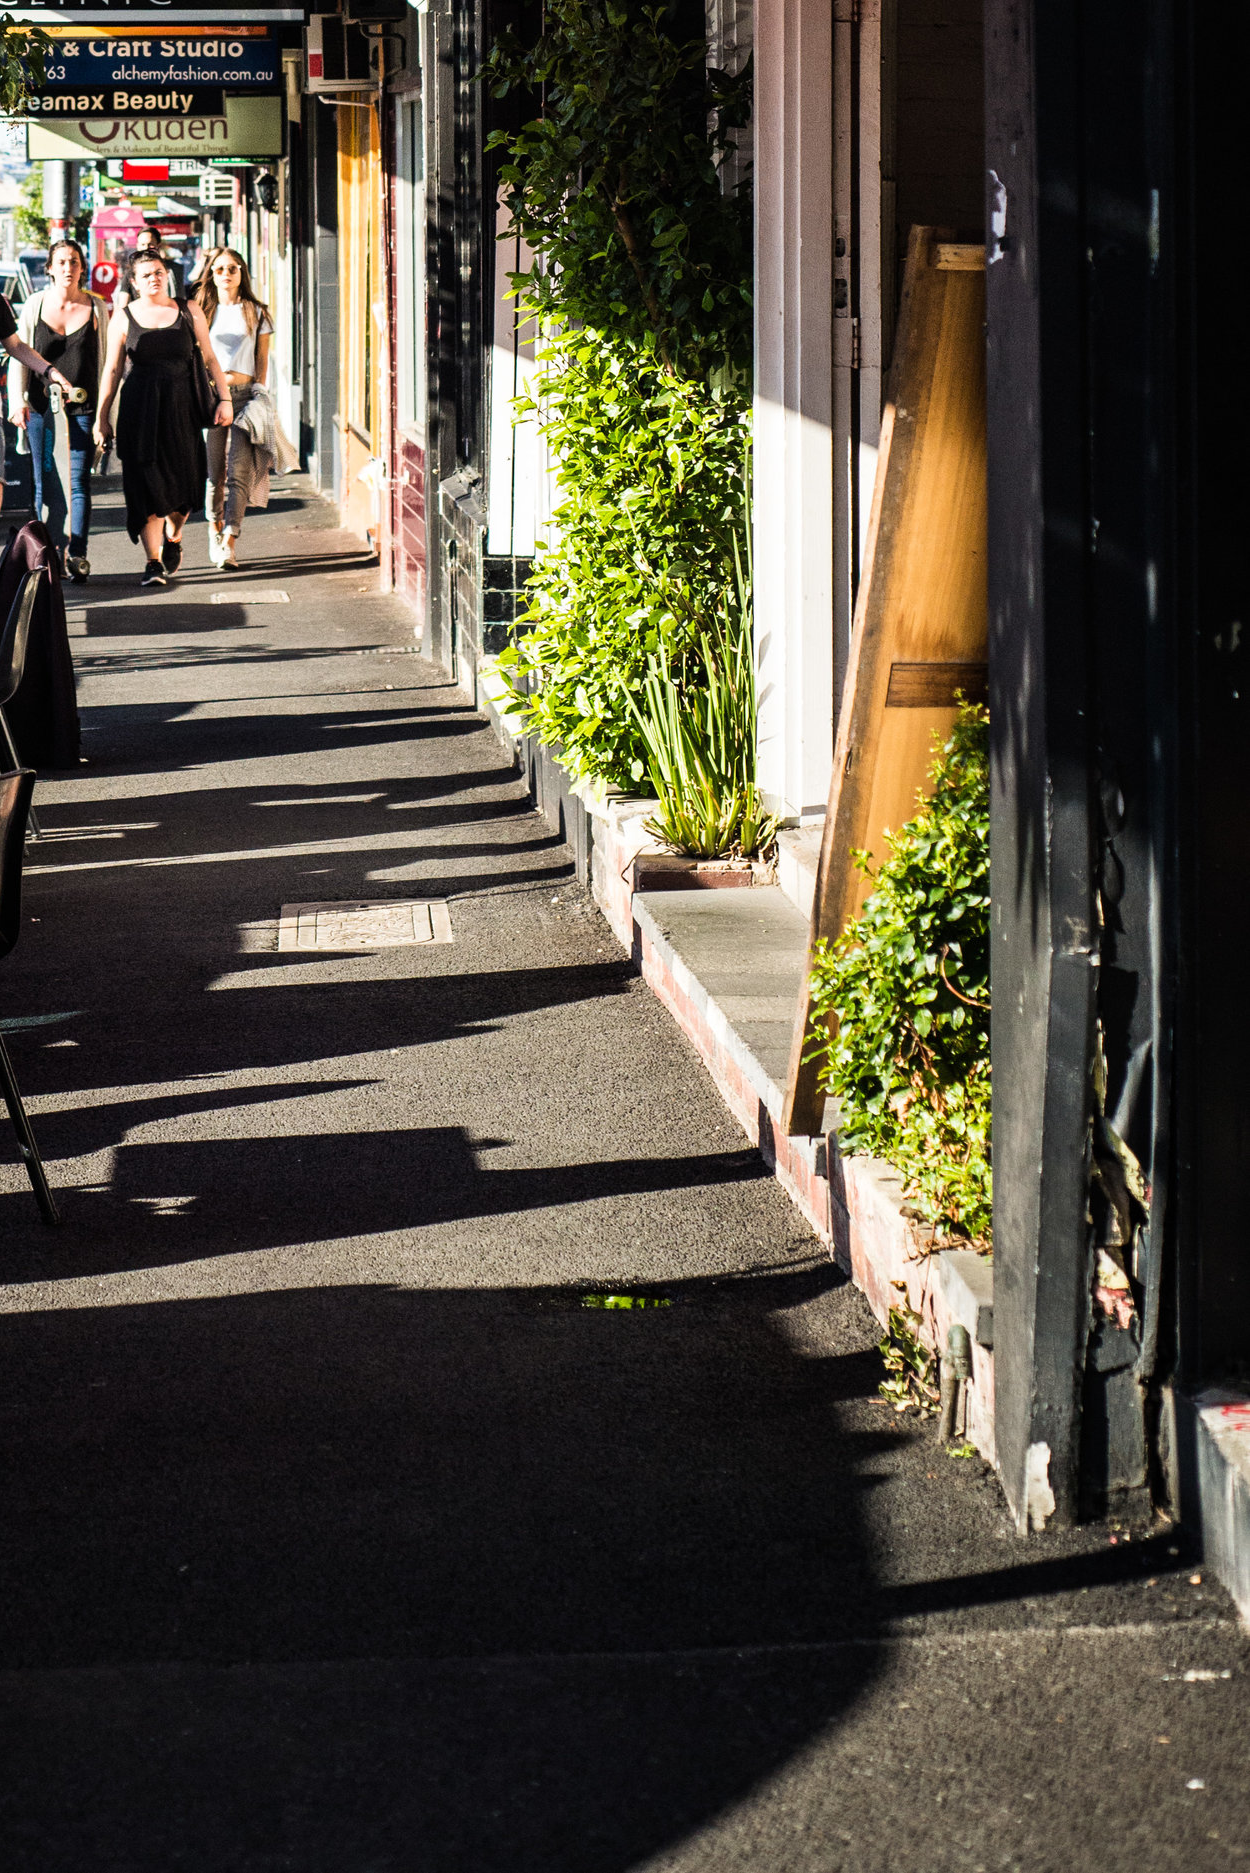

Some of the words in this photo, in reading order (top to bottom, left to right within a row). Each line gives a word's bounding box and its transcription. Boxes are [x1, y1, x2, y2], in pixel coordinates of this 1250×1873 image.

[88, 40, 152, 57] Craft
[160, 40, 244, 58] Studio
[43, 65, 66, 80] 63
[112, 64, 274, 84] alchemyfashion.com.au
[113, 91, 194, 114] Beauty
